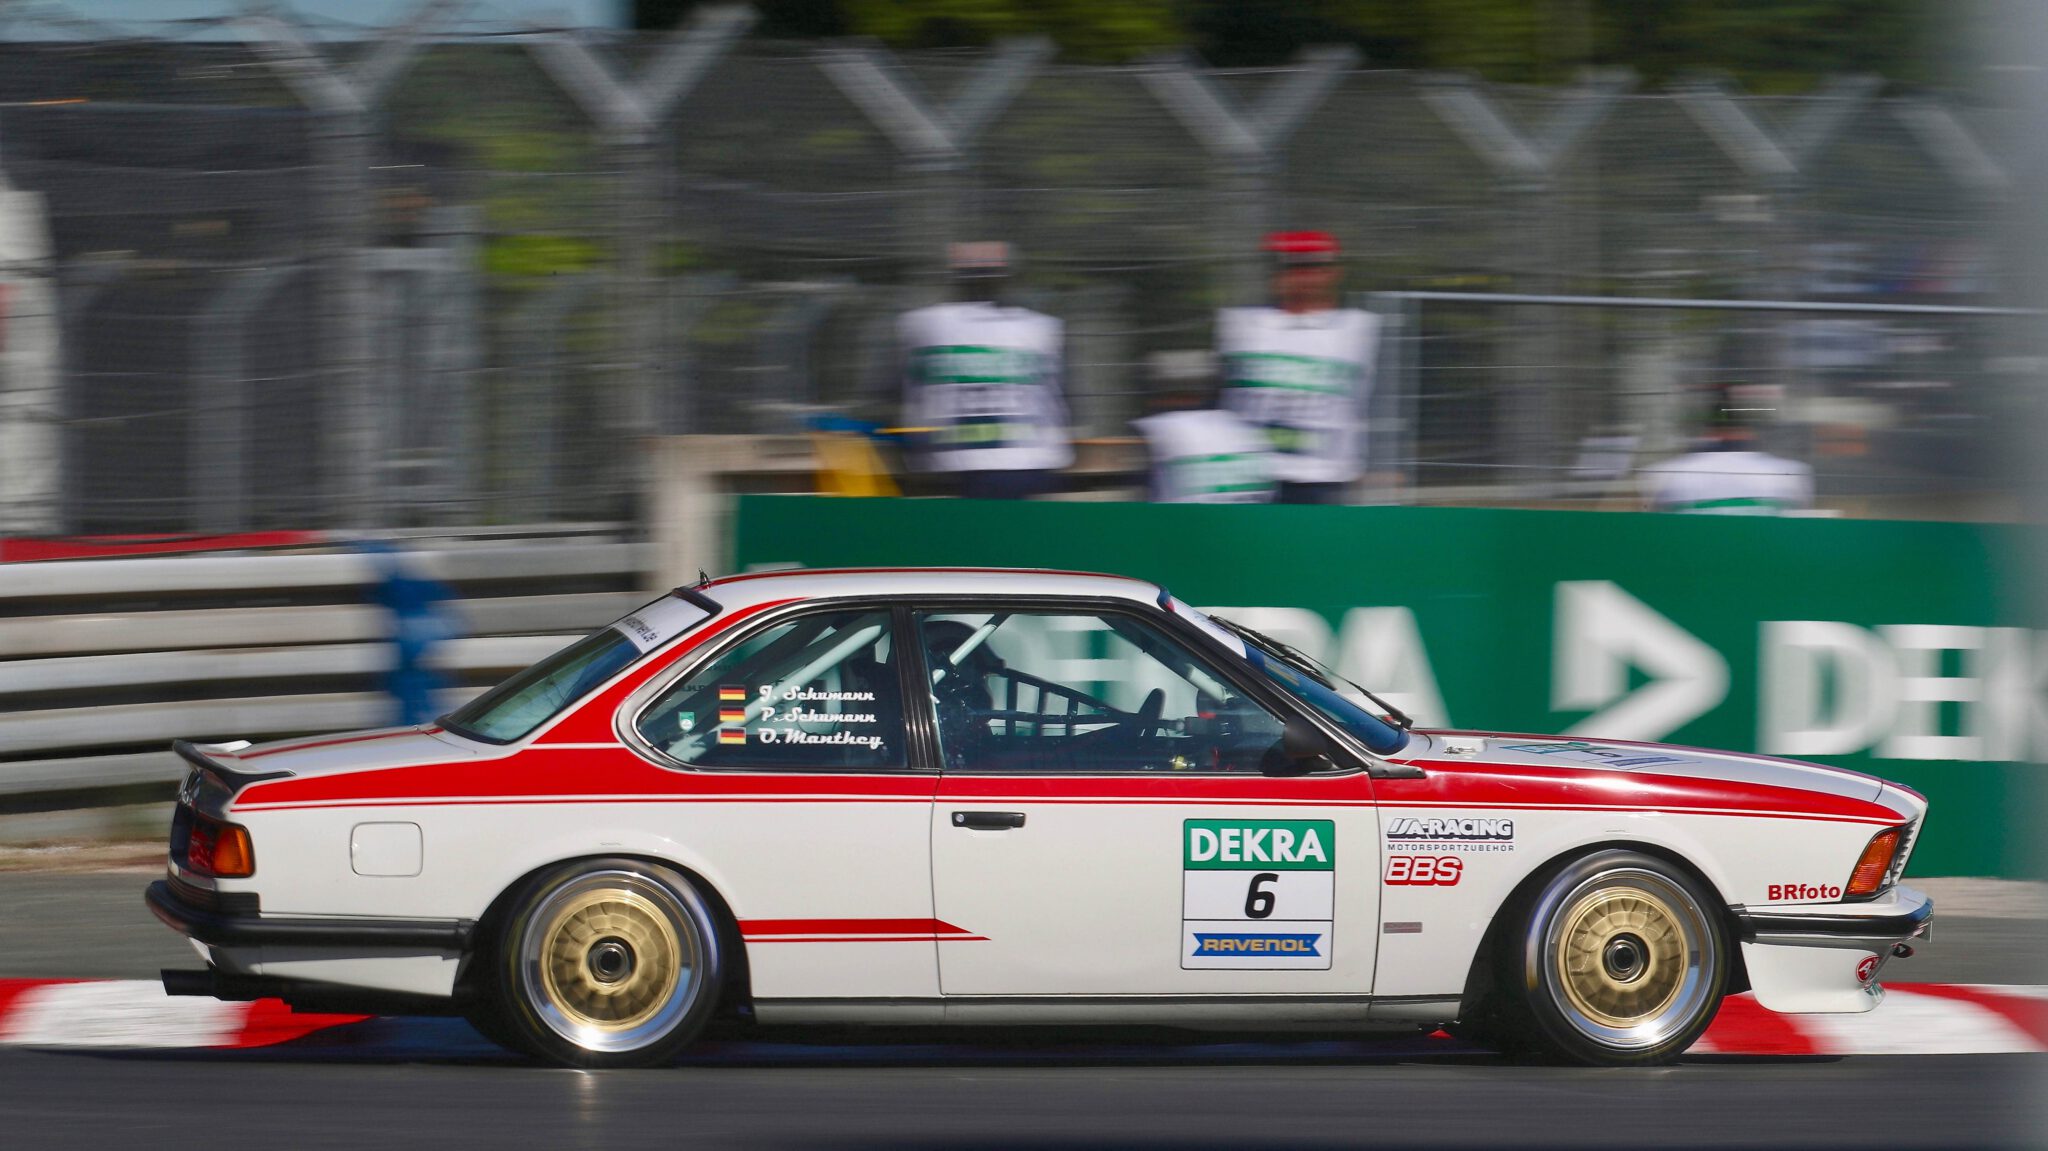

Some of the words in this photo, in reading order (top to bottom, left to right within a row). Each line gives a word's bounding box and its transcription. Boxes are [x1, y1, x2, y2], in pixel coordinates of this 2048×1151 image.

[783, 685, 876, 701] Schumann
[782, 706, 877, 723] Schumann
[784, 728, 884, 750] Manthey
[1190, 828, 1327, 863] DEKRA
[1384, 856, 1464, 886] BBS
[1244, 872, 1280, 919] 6
[1768, 883, 1841, 900] BRfoto
[1202, 938, 1312, 952] RAVENOL
